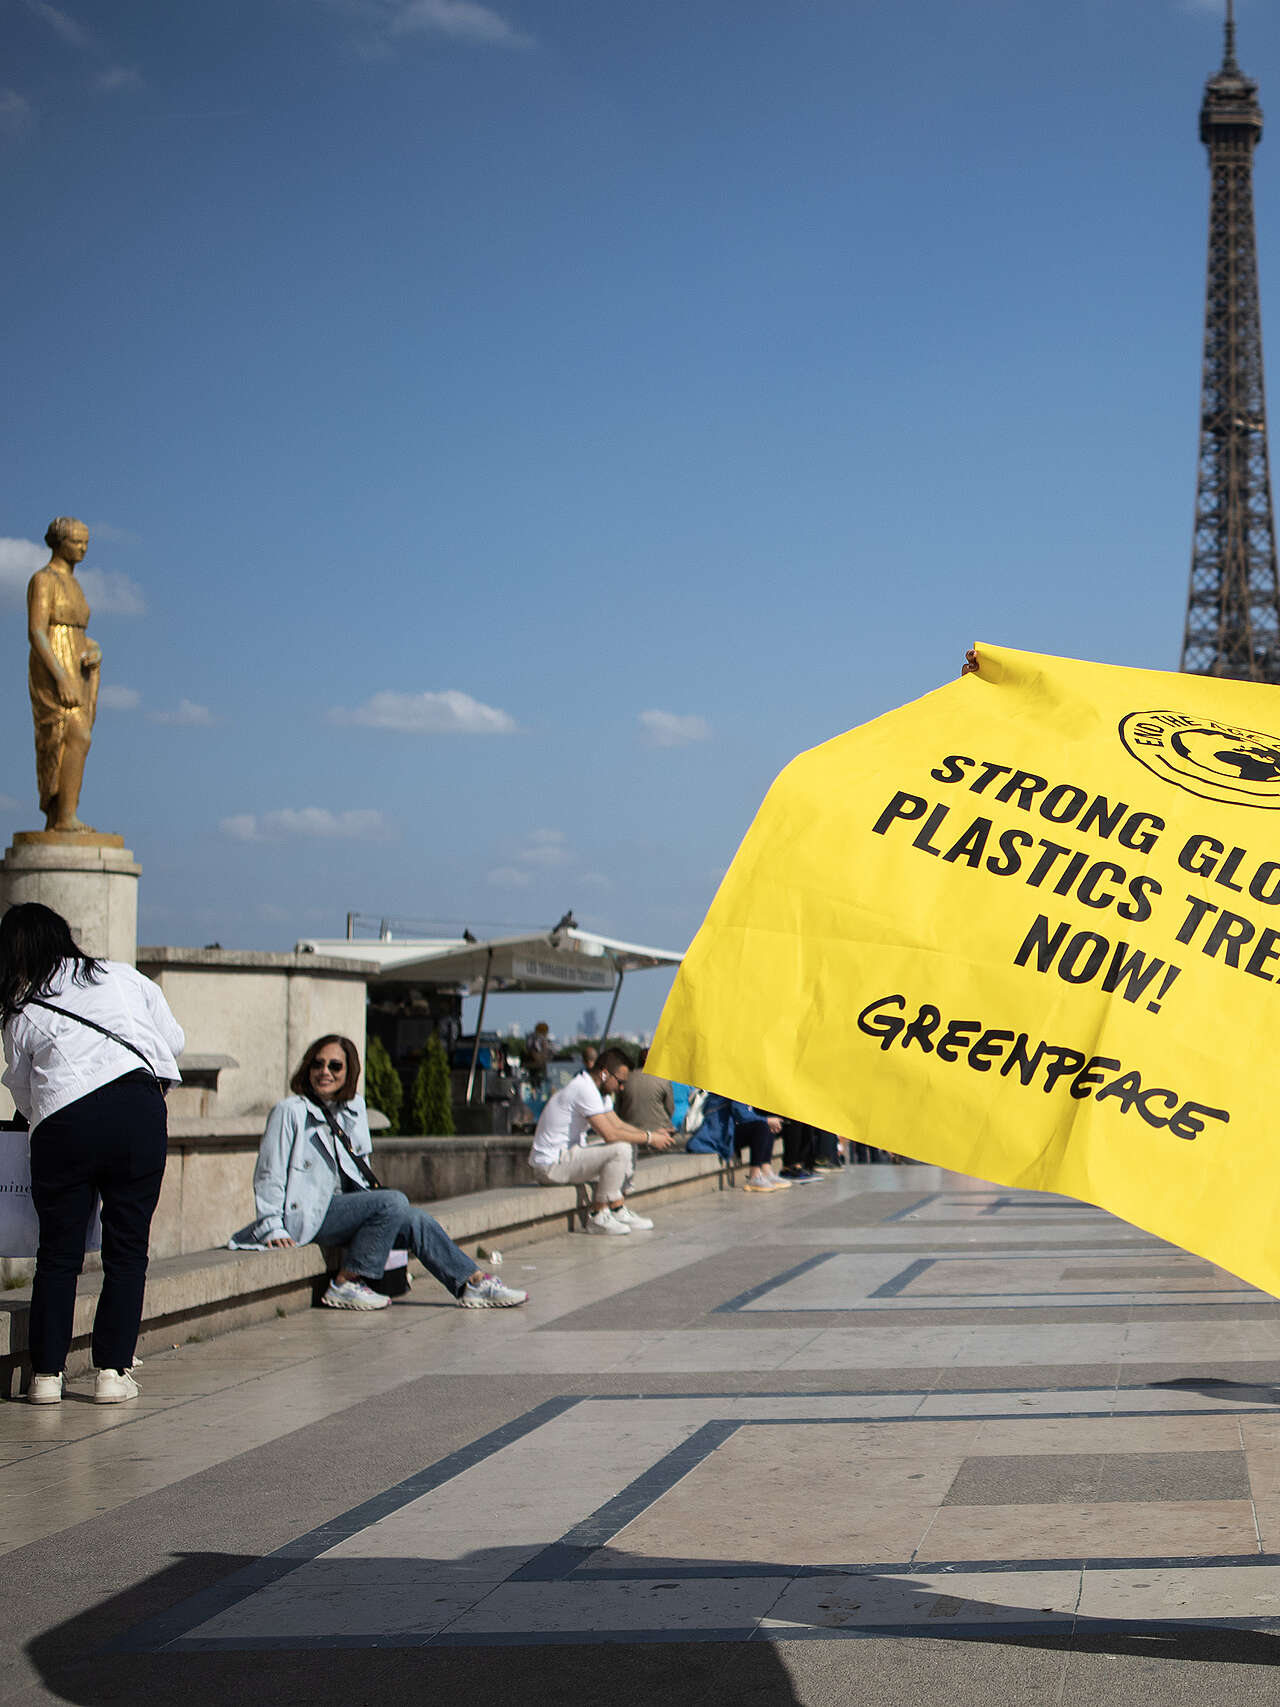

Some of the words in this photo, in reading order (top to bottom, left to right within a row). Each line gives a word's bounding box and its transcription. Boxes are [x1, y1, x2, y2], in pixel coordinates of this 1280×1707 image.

[1133, 720, 1166, 748] END
[1150, 715, 1202, 728] THE
[1211, 722, 1262, 741] AGE
[931, 756, 1165, 854] STRONG
[872, 791, 1162, 921] PLASTICS
[1014, 914, 1181, 1014] NOW!
[858, 995, 1229, 1140] GREENPEACE
